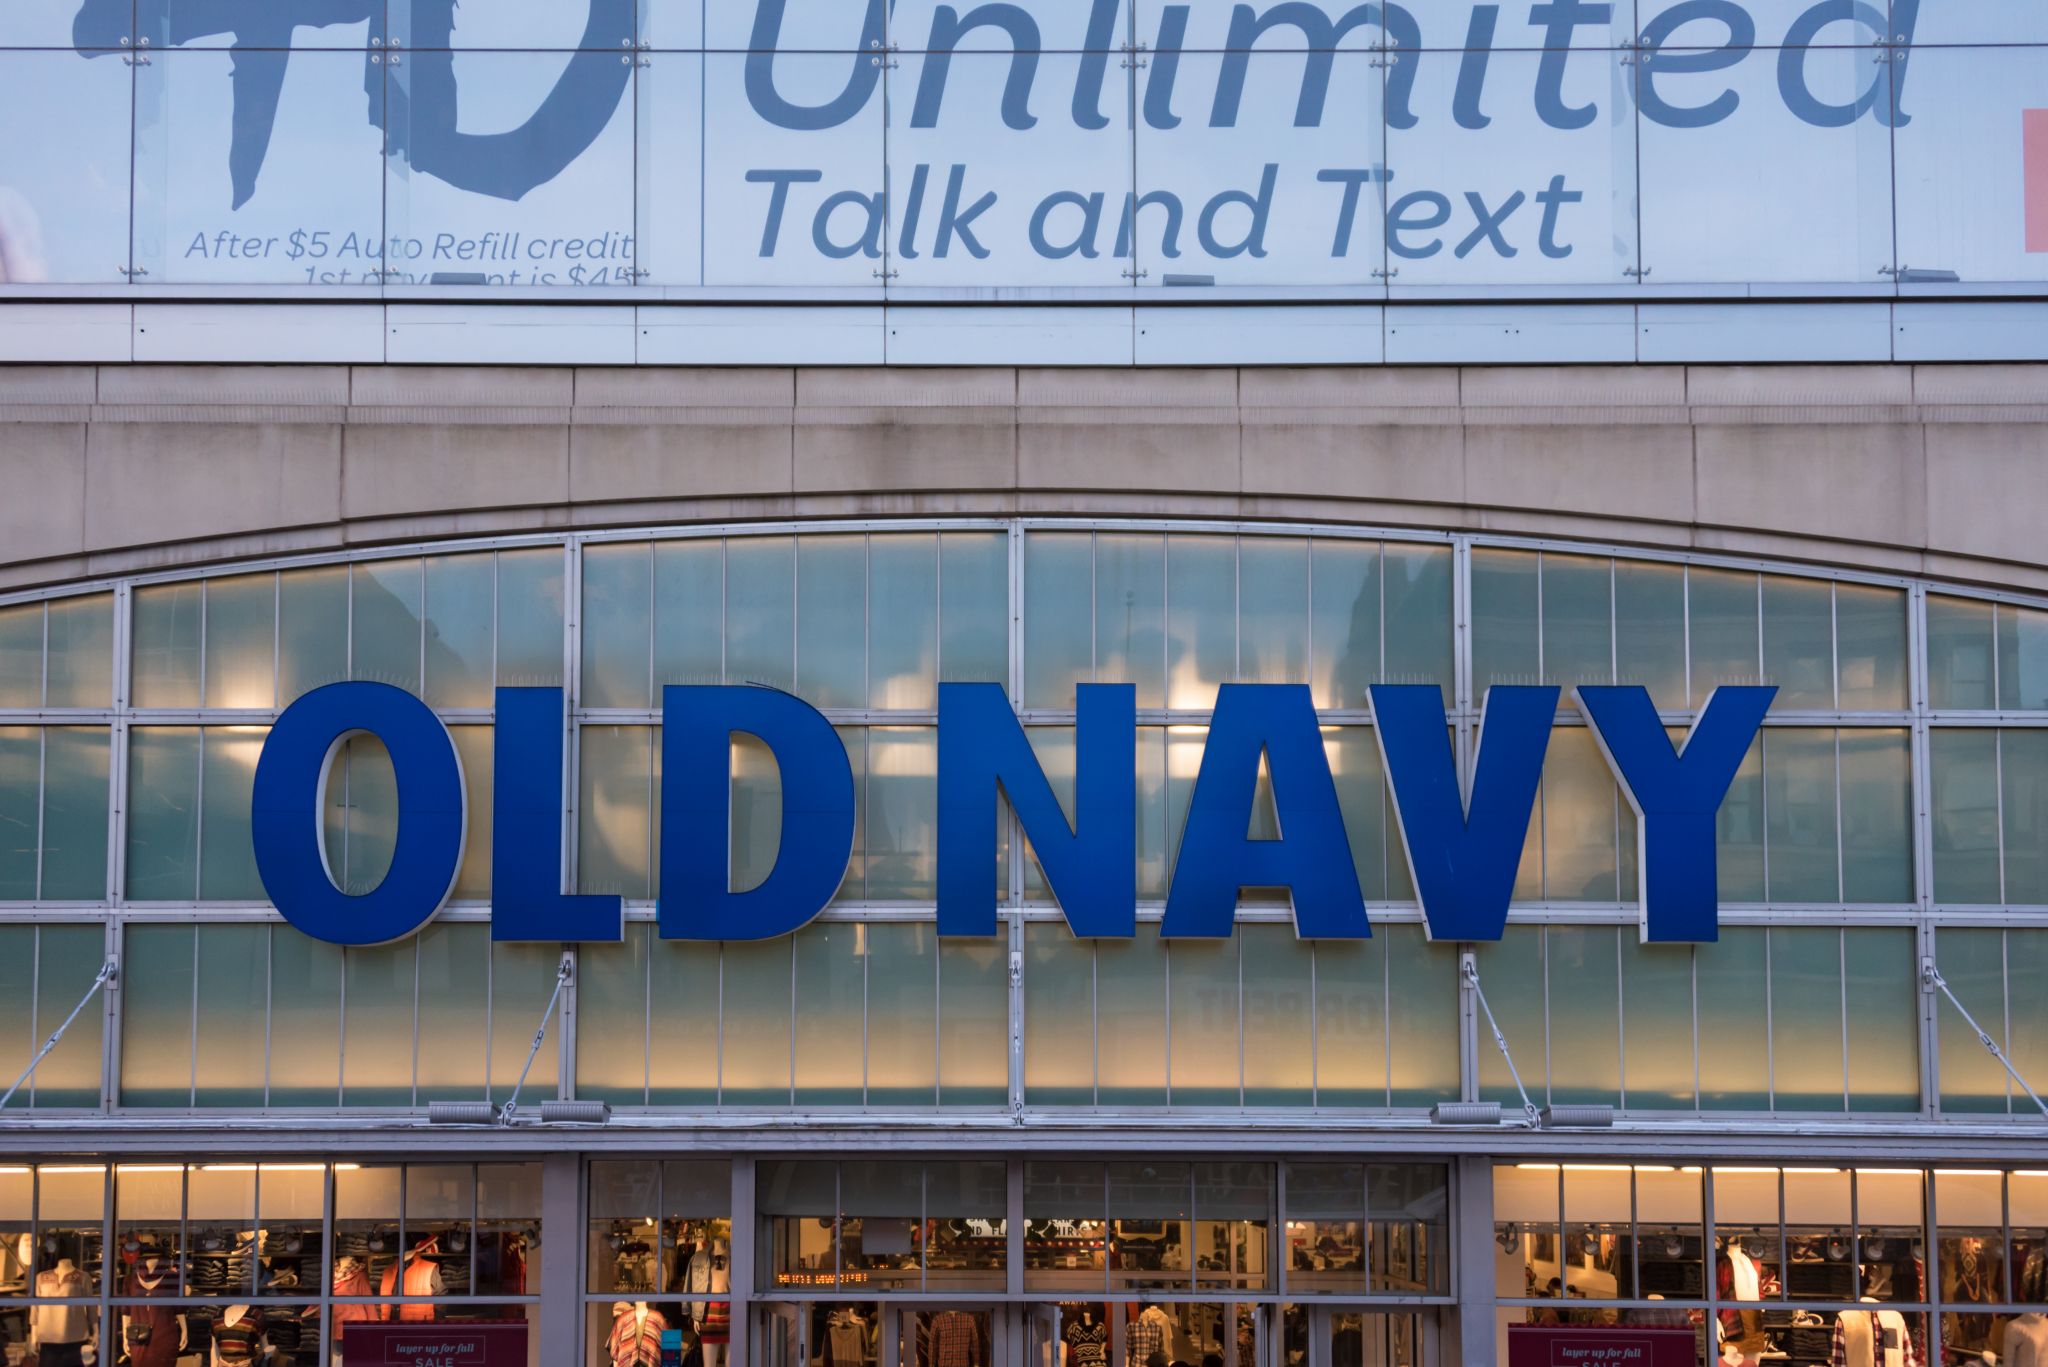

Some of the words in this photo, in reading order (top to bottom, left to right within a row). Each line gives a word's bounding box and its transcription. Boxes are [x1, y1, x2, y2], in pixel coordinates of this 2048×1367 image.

[744, 163, 998, 260] Talk
[1028, 163, 1279, 260] and
[1316, 168, 1583, 260] Text
[185, 230, 278, 258] After
[286, 228, 330, 261] $5
[337, 231, 422, 259] Auto
[432, 232, 520, 260] Refill
[527, 231, 634, 260] credit
[252, 680, 857, 947] OLD
[937, 682, 1780, 945] NAVY
[396, 1343, 423, 1355] layer
[425, 1345, 438, 1355] up
[438, 1343, 456, 1355] for
[454, 1343, 475, 1355] fall
[1562, 1347, 1590, 1358] layer
[1591, 1349, 1605, 1359] up
[1605, 1347, 1622, 1359] for
[1621, 1347, 1641, 1359] fall
[415, 1357, 455, 1367] SALE
